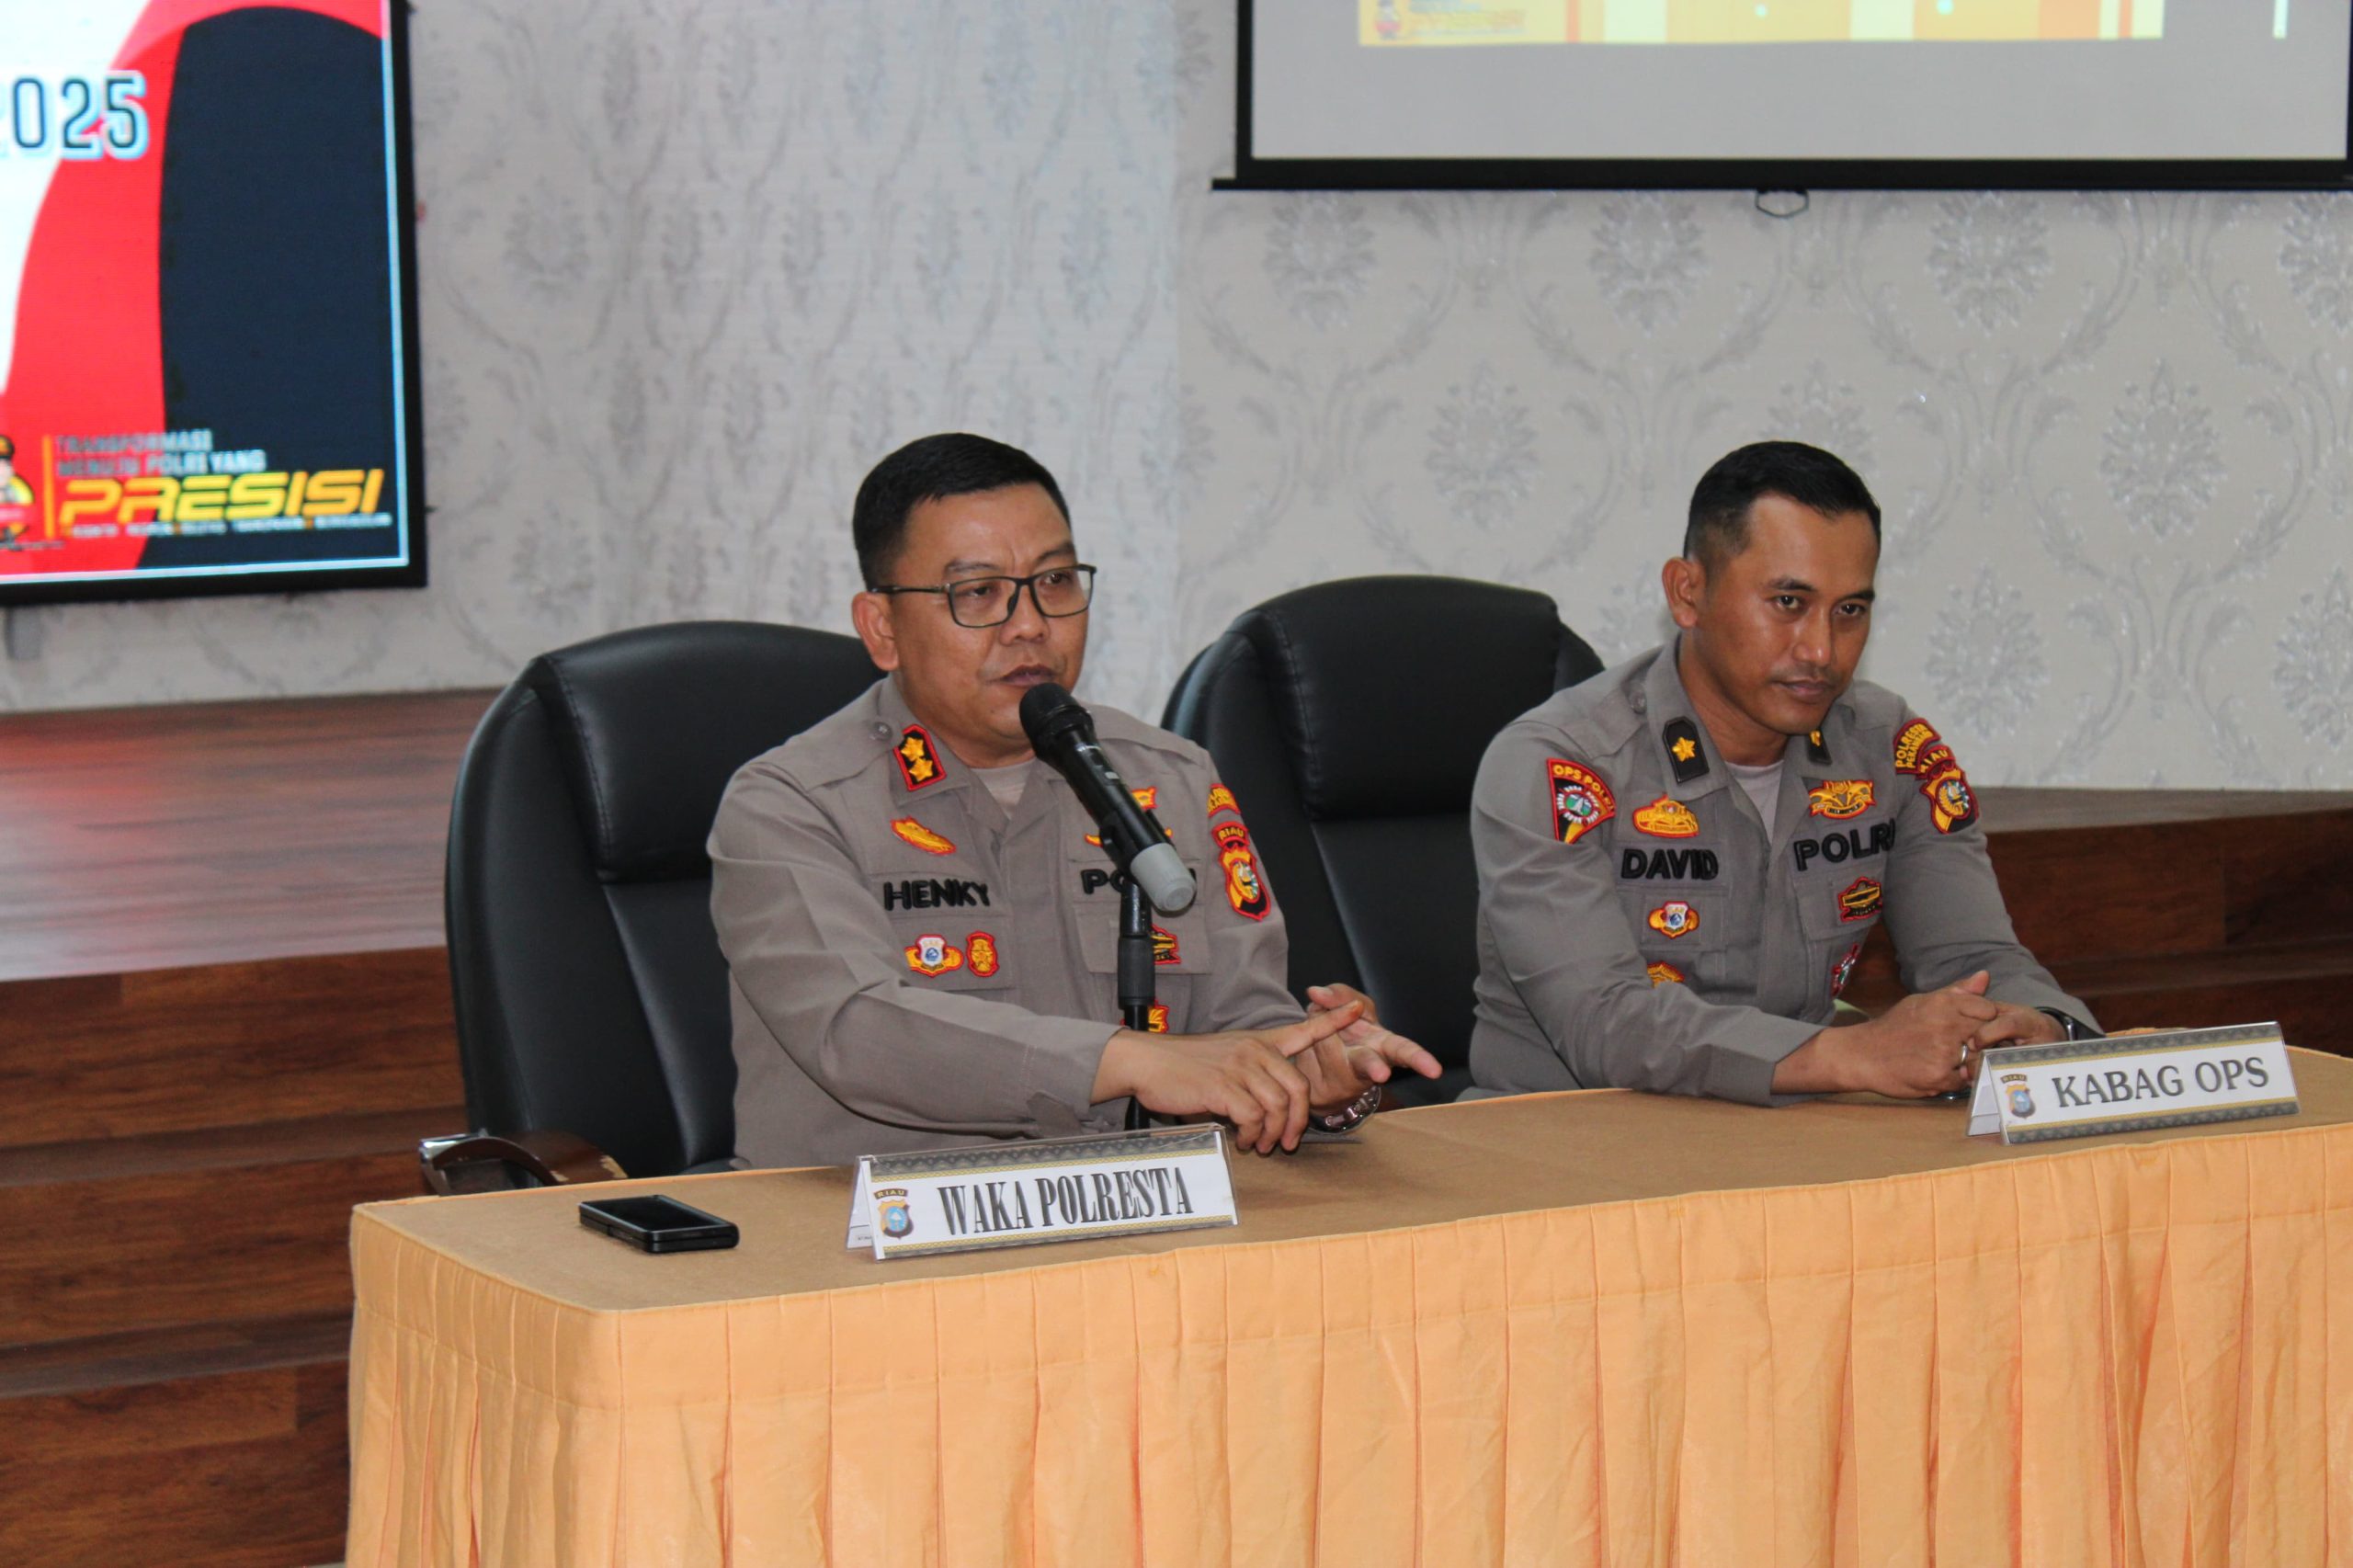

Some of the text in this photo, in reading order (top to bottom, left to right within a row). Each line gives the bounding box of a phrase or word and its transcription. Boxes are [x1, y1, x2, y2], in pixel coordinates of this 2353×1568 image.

[0, 73, 147, 156] 025
[60, 469, 384, 526] PRESISI
[1553, 765, 1582, 779] OPS
[1620, 848, 1720, 881] DAVID
[1793, 818, 1896, 871] POLRI
[883, 879, 991, 911] HENKY
[2052, 1056, 2268, 1108] KABAG OPS
[938, 1167, 1194, 1235] WAKA POLRESTA
